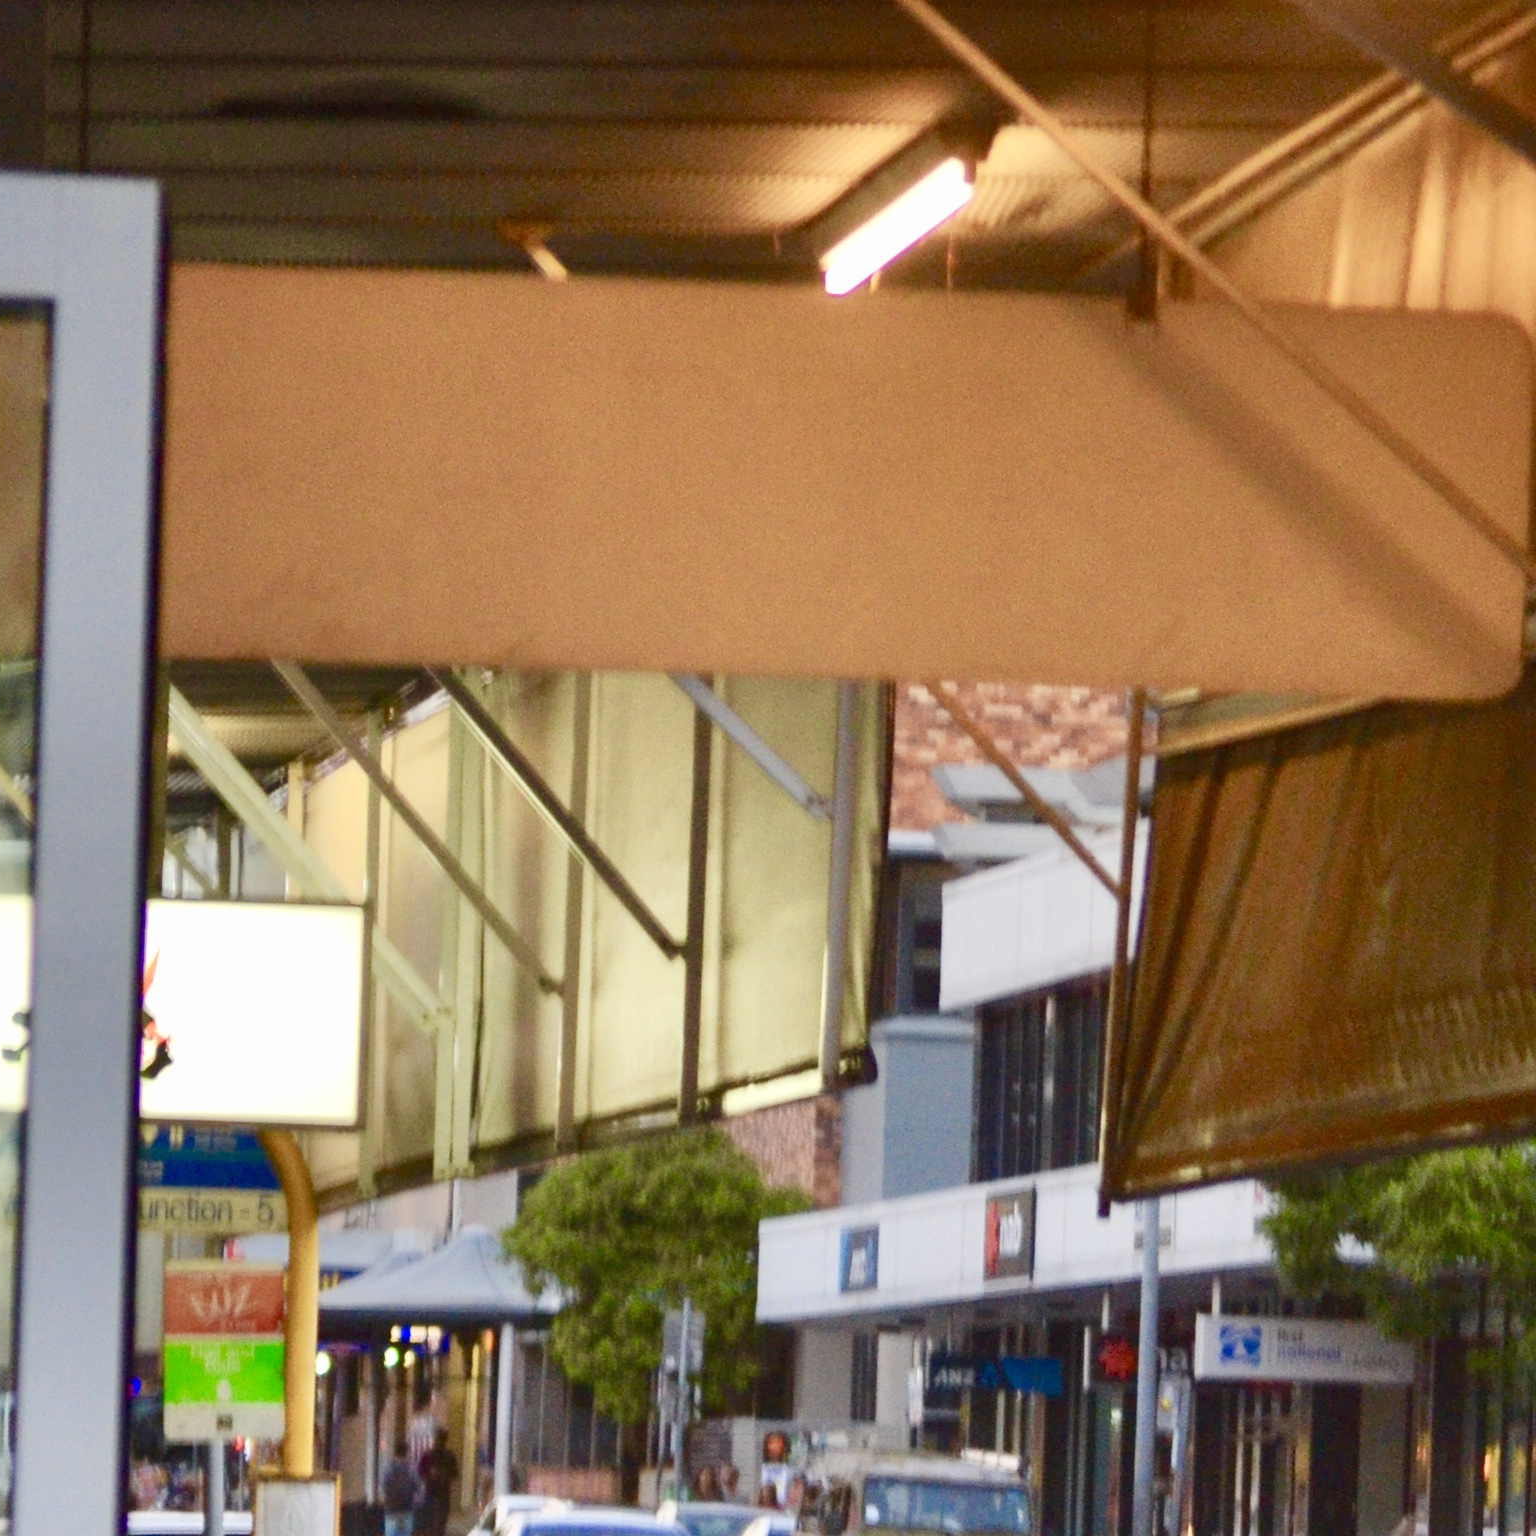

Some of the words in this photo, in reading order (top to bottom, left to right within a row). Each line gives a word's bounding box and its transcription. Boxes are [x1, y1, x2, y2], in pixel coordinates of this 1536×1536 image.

[257, 1194, 275, 1224] 5
[999, 1199, 1022, 1258] nab
[934, 1367, 975, 1388] ANZ
